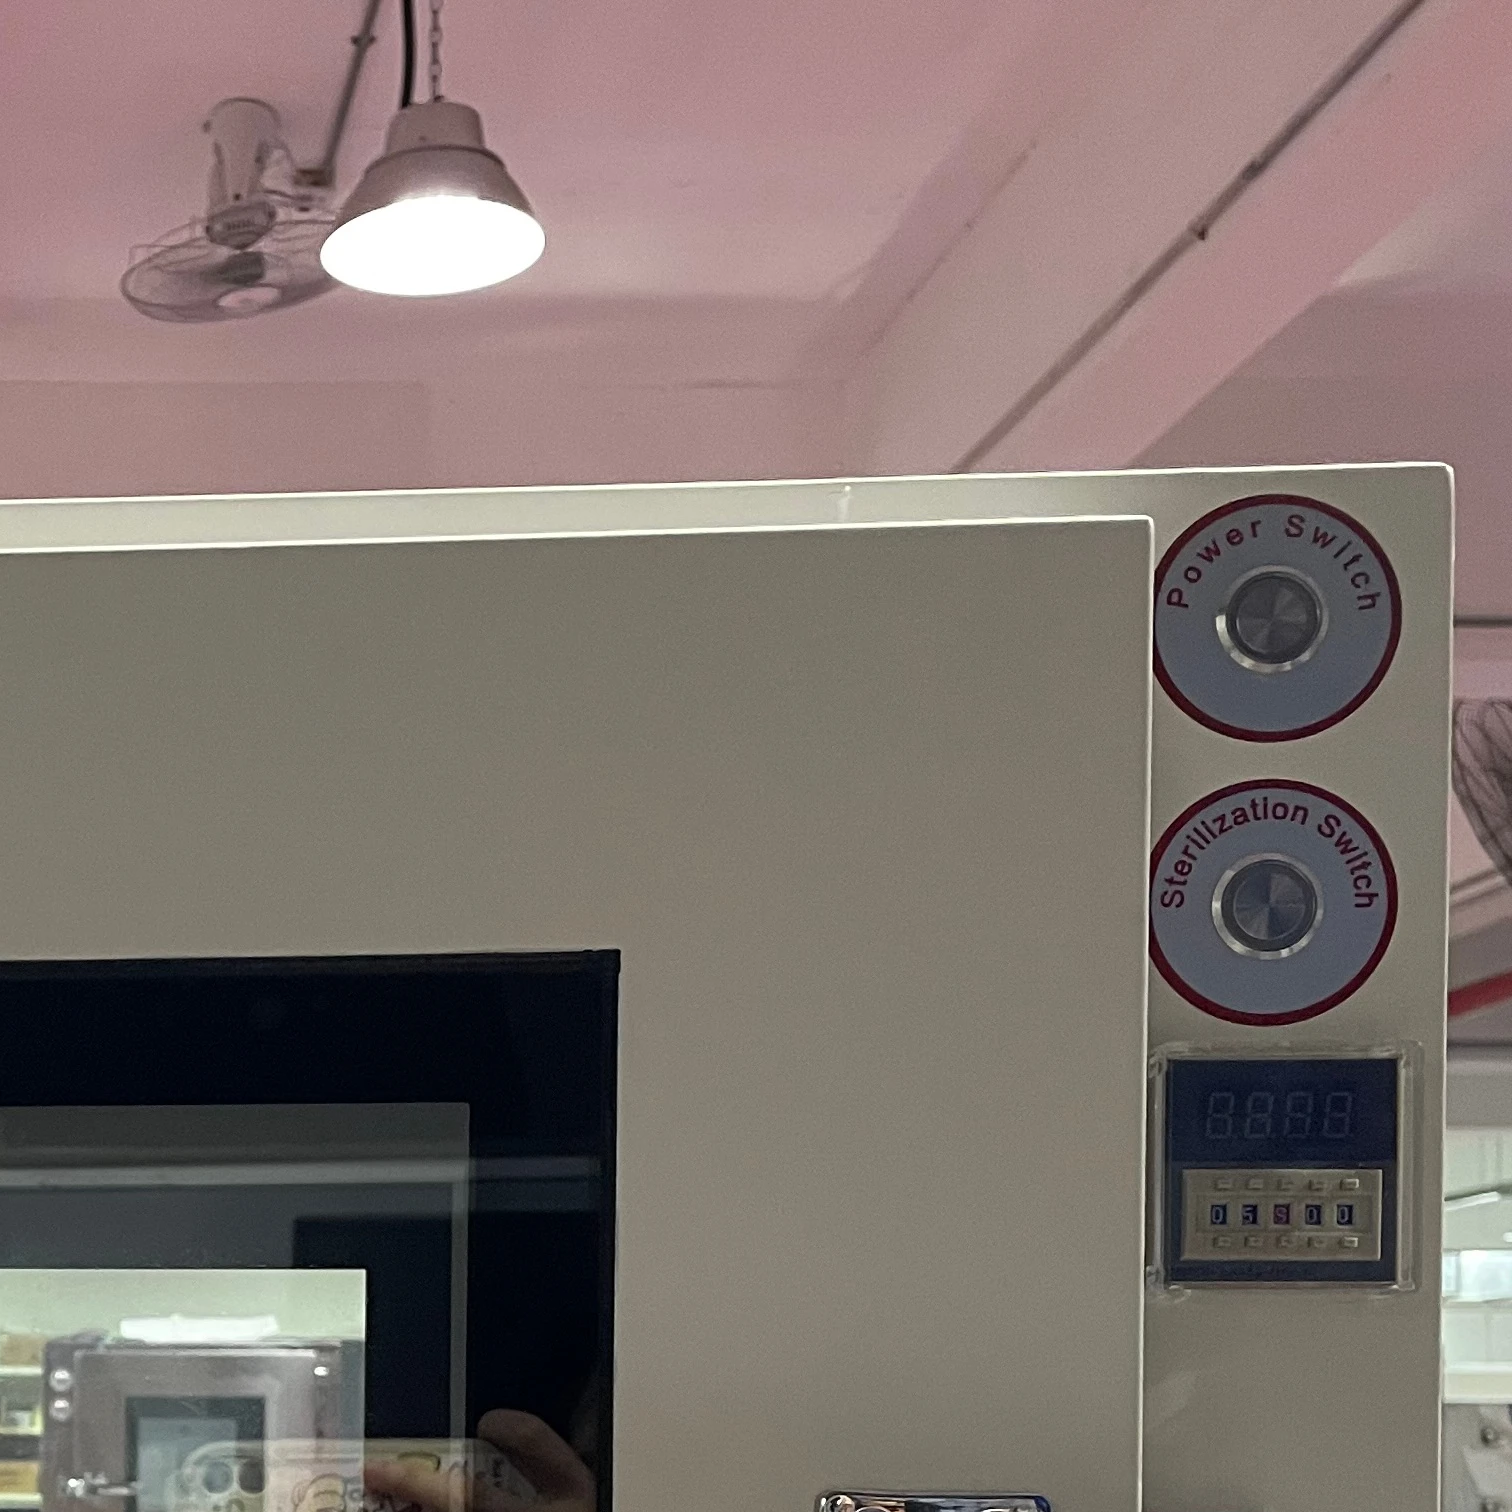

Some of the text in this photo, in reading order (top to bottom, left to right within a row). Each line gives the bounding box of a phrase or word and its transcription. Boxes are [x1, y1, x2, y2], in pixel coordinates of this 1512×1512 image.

[1166, 514, 1382, 611] Power Switch
[1160, 796, 1379, 909] Sterilization Switch
